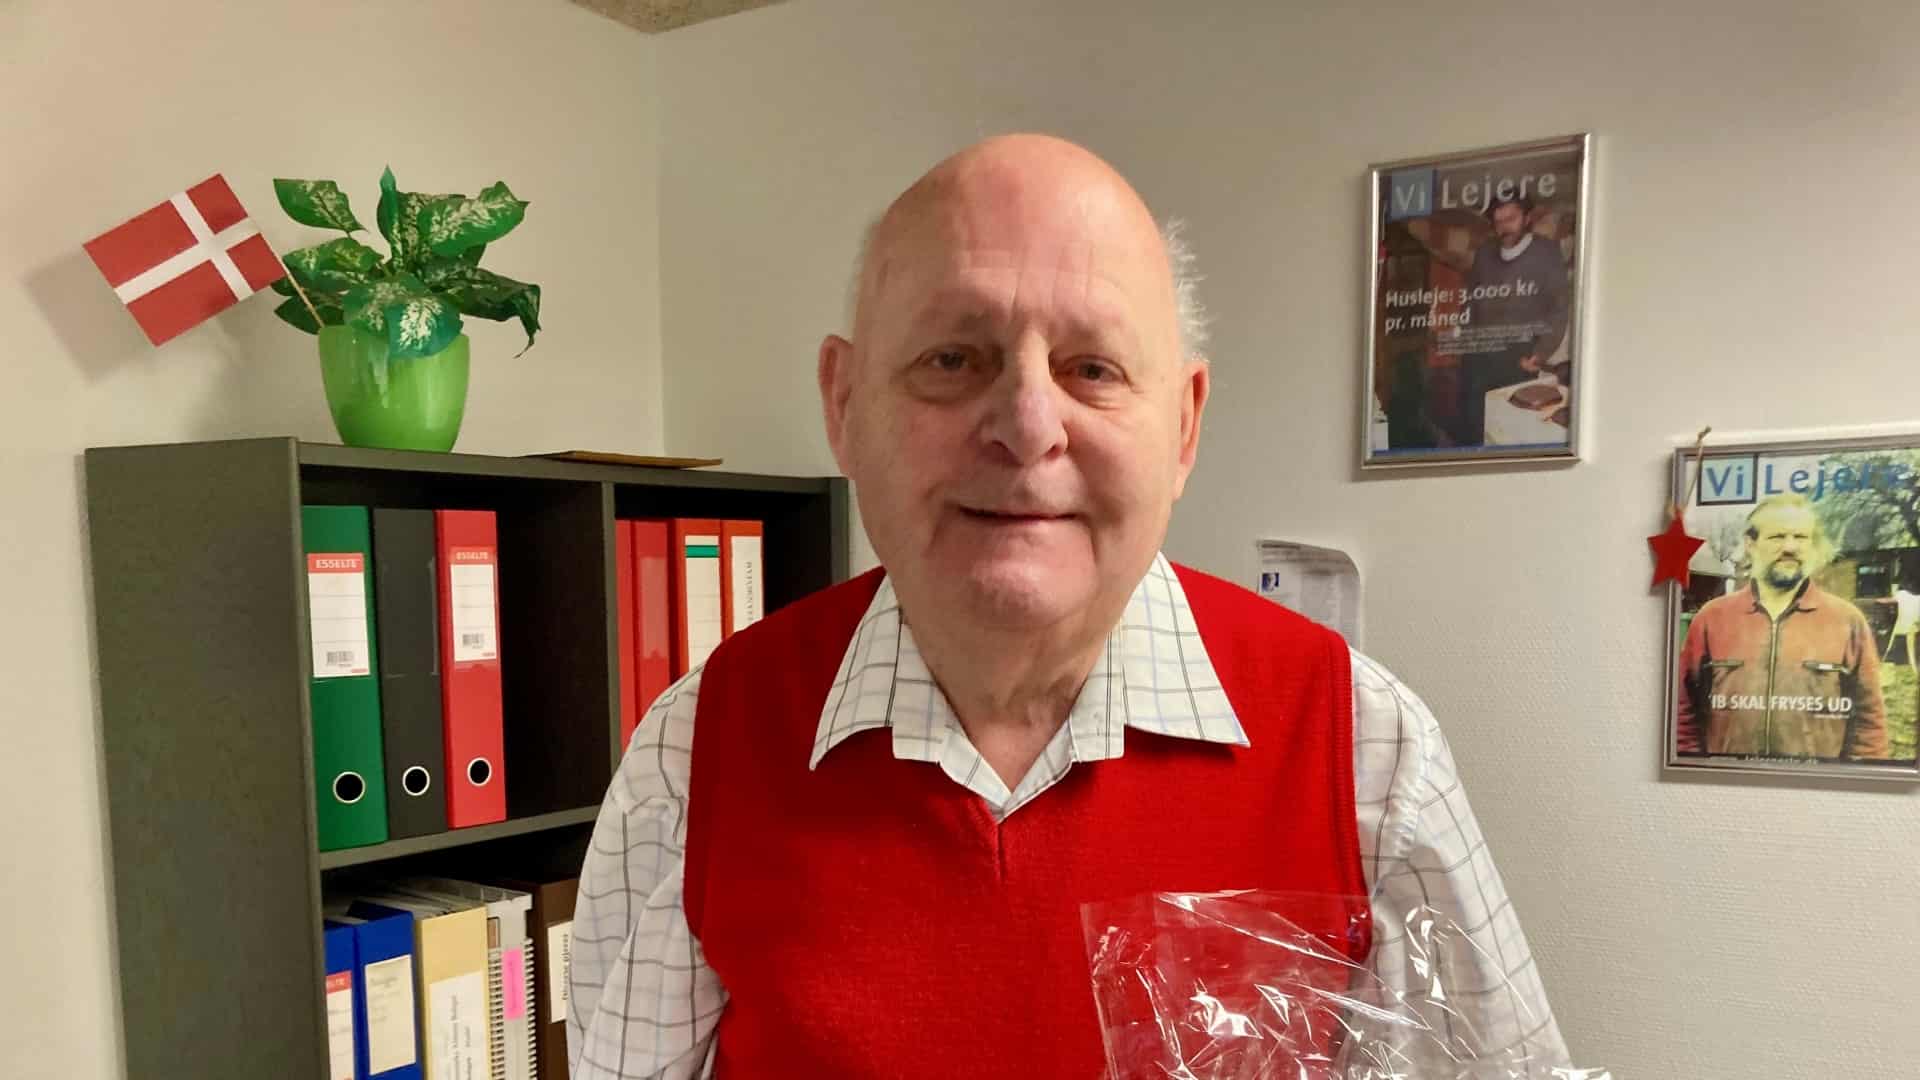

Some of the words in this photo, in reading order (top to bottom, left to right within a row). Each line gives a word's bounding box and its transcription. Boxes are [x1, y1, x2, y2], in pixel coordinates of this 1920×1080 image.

[1394, 182, 1426, 212] Vi
[1442, 173, 1556, 214] Lejere
[1385, 286, 1454, 308] Husleje:
[1458, 285, 1512, 305] 3.000
[1516, 279, 1539, 297] kr.
[1385, 316, 1407, 336] pr.
[1410, 307, 1471, 329] måned
[1706, 464, 1745, 497] Vi
[1764, 461, 1910, 502] Lejere
[316, 559, 358, 569] ESSELTE
[456, 551, 489, 561] ESSELTE
[1729, 694, 1767, 711] SKAL
[1770, 695, 1824, 712] FRYSES
[1827, 696, 1853, 713] UD
